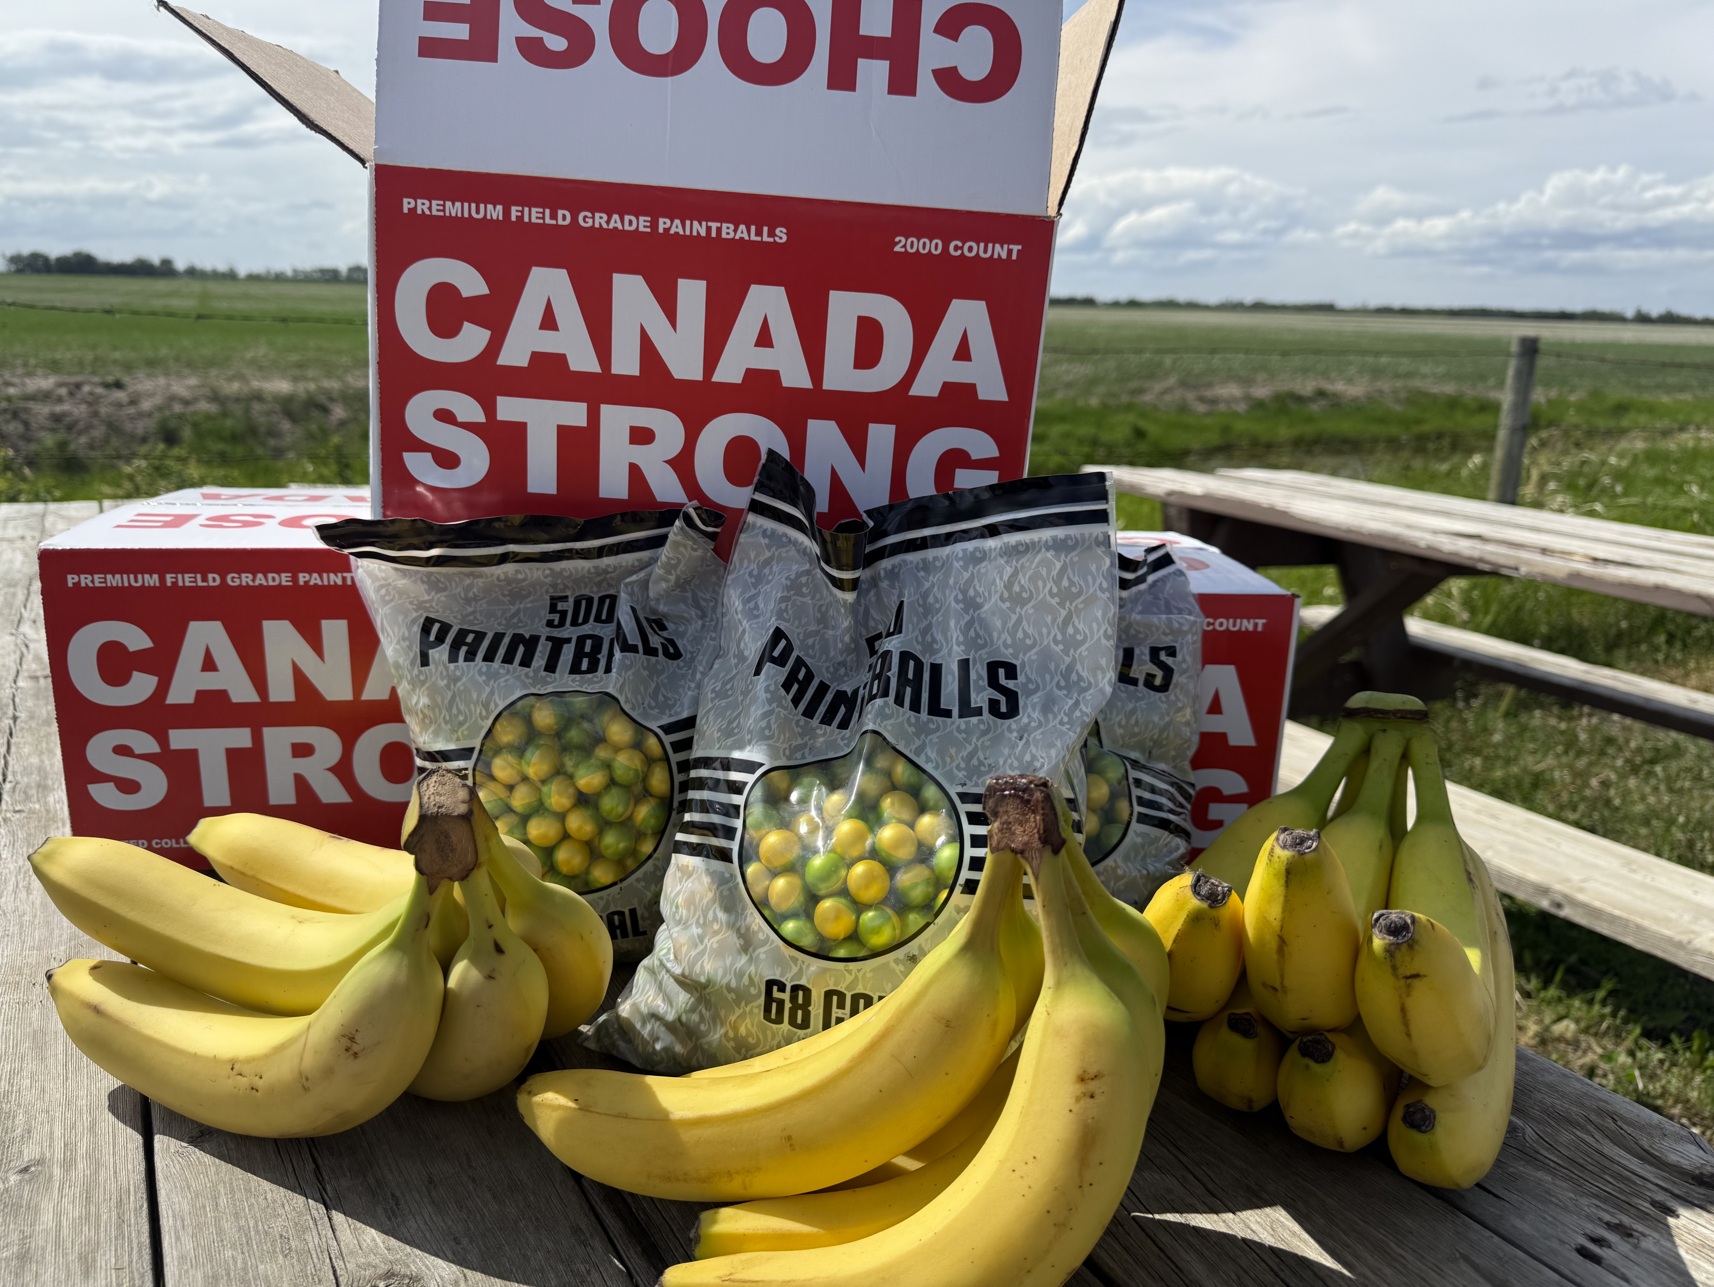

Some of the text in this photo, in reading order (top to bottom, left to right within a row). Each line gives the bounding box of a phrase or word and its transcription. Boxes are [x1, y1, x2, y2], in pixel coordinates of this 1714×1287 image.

[417, 0, 1022, 104] CHOOSE
[402, 197, 788, 243] PREMIUM FIELD GRADE PAINTBALLS
[893, 236, 1022, 260] 2000 COUNT
[395, 257, 1009, 402] CANADA
[402, 389, 1001, 514] STRONG
[113, 513, 353, 530] OSE
[66, 571, 356, 588] PREMIUM FIELD GRADE PAINT
[545, 593, 619, 629] 500
[1202, 617, 1267, 632] COUNT
[66, 619, 401, 707] CAN
[753, 626, 1021, 731] PAINBALLS
[86, 722, 417, 811] STRO
[600, 907, 648, 941] AL
[763, 978, 812, 1031] 68
